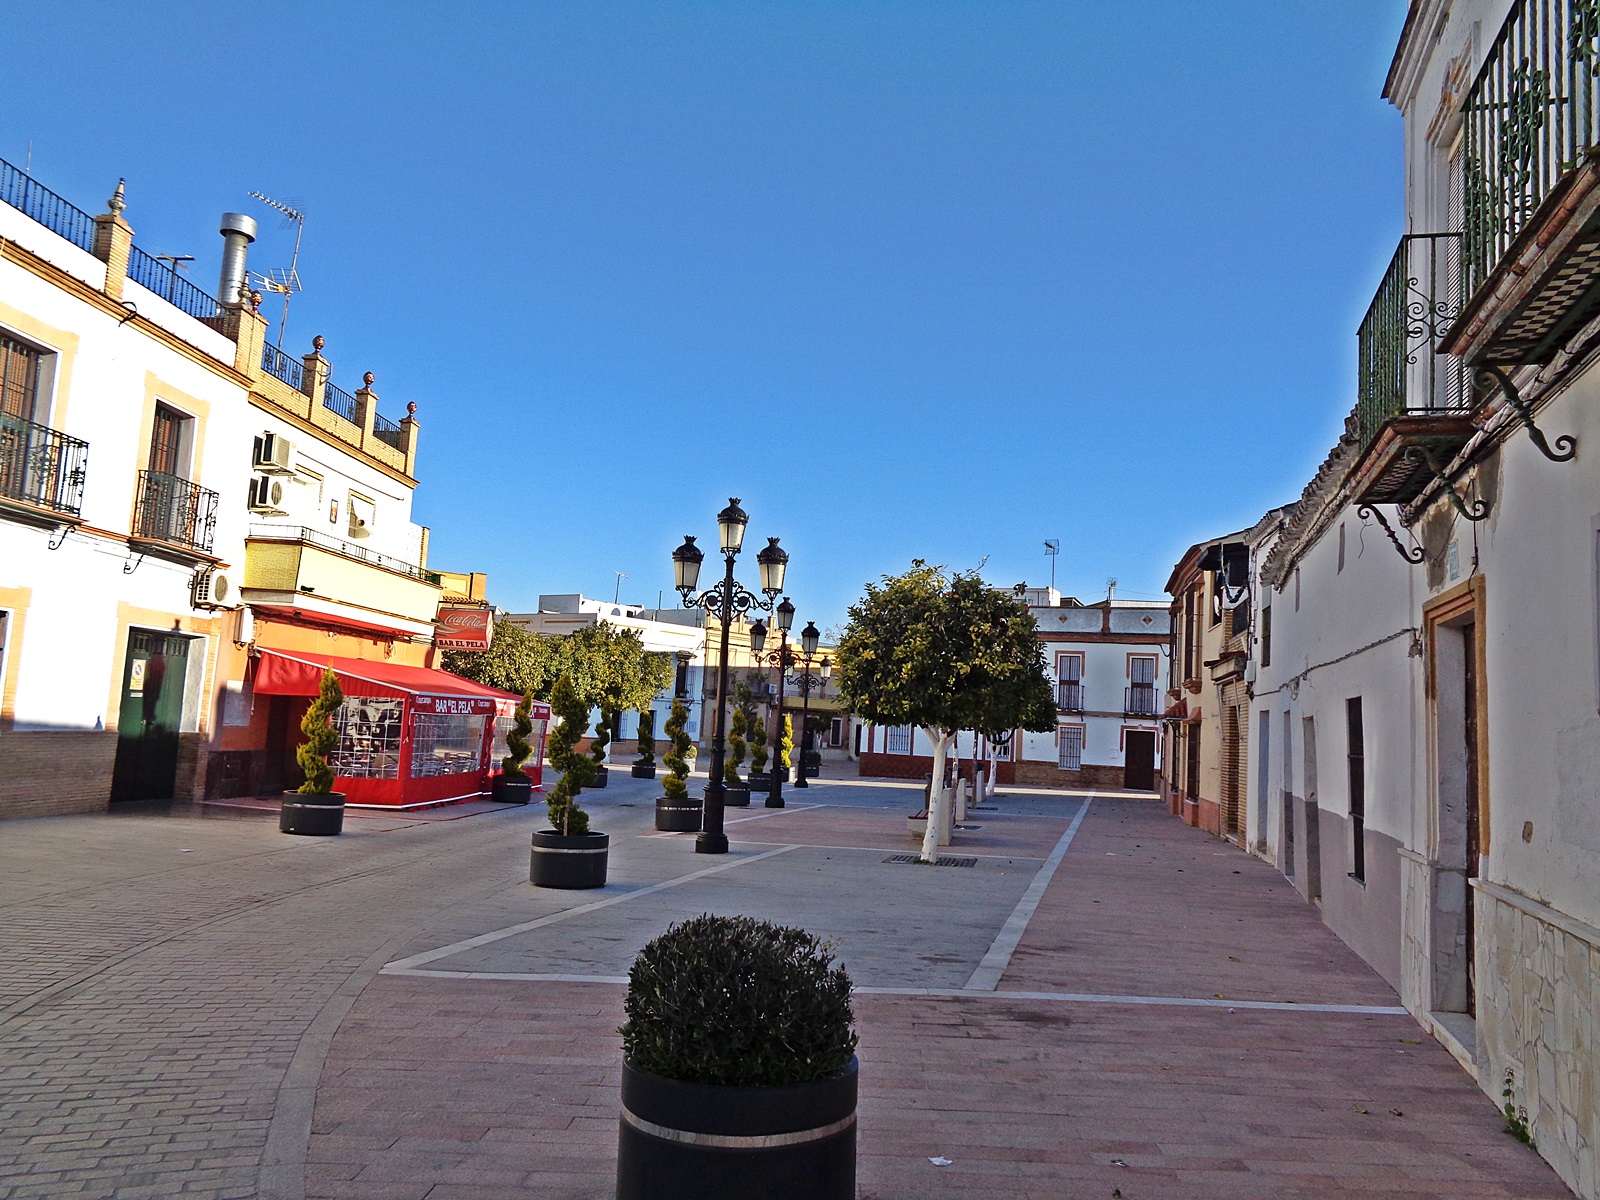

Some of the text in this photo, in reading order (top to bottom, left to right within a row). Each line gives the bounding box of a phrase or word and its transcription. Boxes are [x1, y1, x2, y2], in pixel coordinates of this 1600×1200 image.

[439, 639, 454, 647] BAR
[455, 640, 465, 648] EL
[435, 699, 447, 713] BAR
